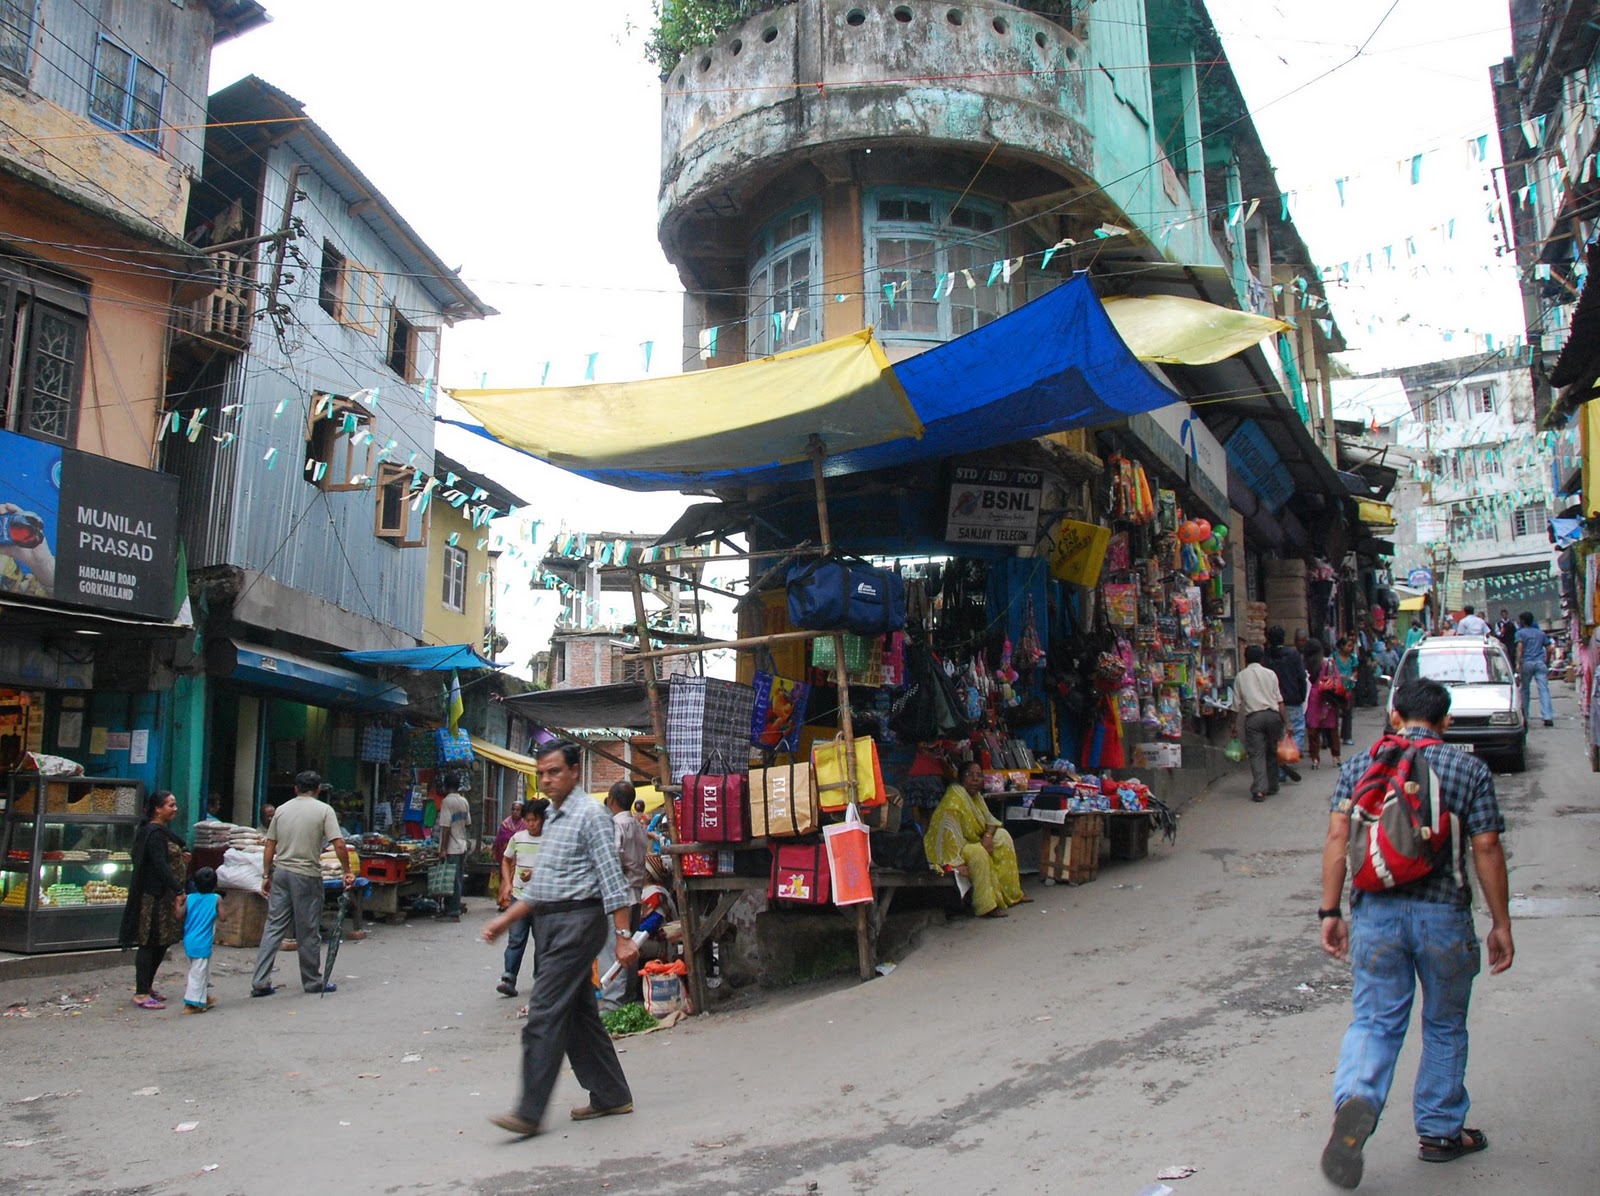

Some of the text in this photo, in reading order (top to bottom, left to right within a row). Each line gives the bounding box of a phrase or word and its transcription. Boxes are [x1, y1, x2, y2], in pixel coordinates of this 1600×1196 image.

[956, 467, 978, 479] STD
[988, 470, 1007, 481] ISD
[1017, 473, 1039, 484] PCO
[982, 490, 1034, 511] BSNL
[77, 506, 157, 540] MUNILAL
[958, 528, 1028, 541] SANJAY TELECOM
[79, 531, 153, 562] PRASAD
[79, 566, 136, 586] HARIJAN ROAD
[79, 582, 134, 601] GORKHALAND
[704, 786, 717, 828] ELLE
[773, 777, 787, 819] ELLE
